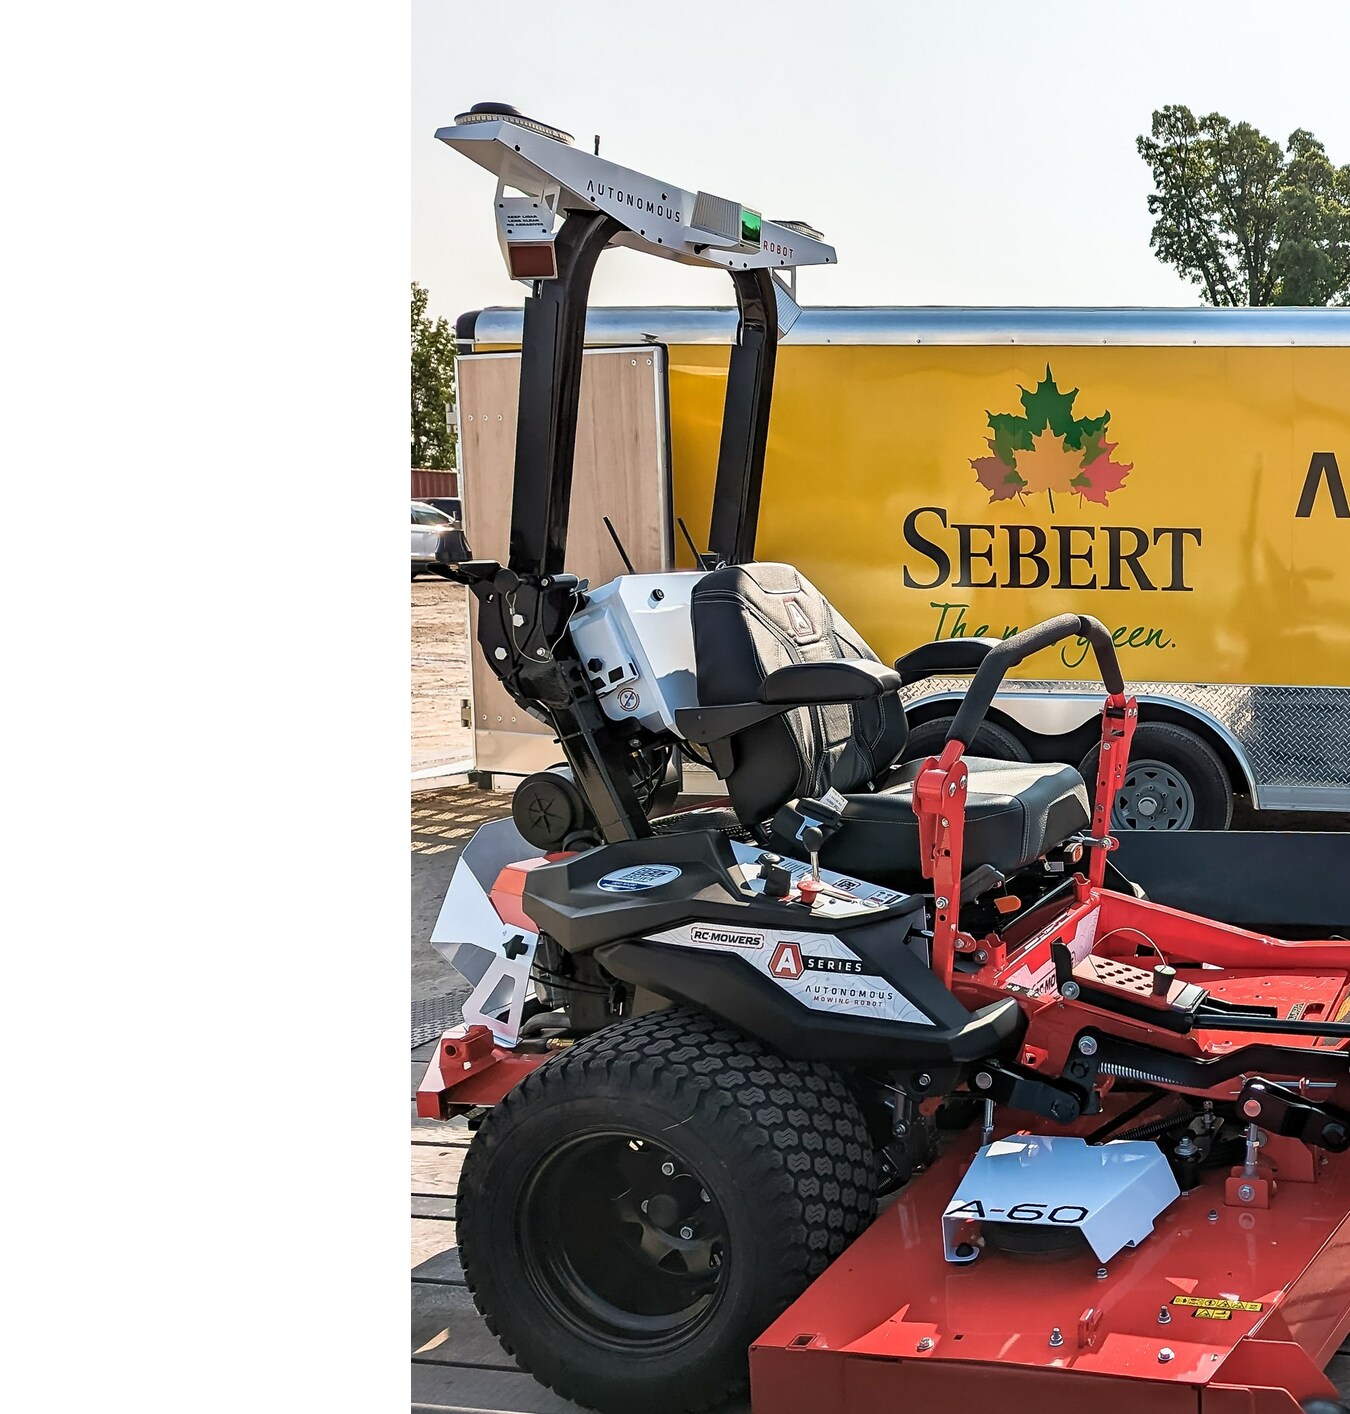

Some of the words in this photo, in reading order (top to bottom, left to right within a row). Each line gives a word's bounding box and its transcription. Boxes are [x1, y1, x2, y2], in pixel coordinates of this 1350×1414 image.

[587, 179, 681, 223] AUTONOMOUS
[763, 240, 793, 258] ROBOT
[1061, 626, 1176, 668] geen.
[807, 958, 862, 972] SERIES
[805, 985, 893, 1000] AUTONOMOUS
[813, 995, 849, 1005] MOWING
[854, 999, 883, 1007] ROBOT
[945, 1200, 1089, 1223] A-60
